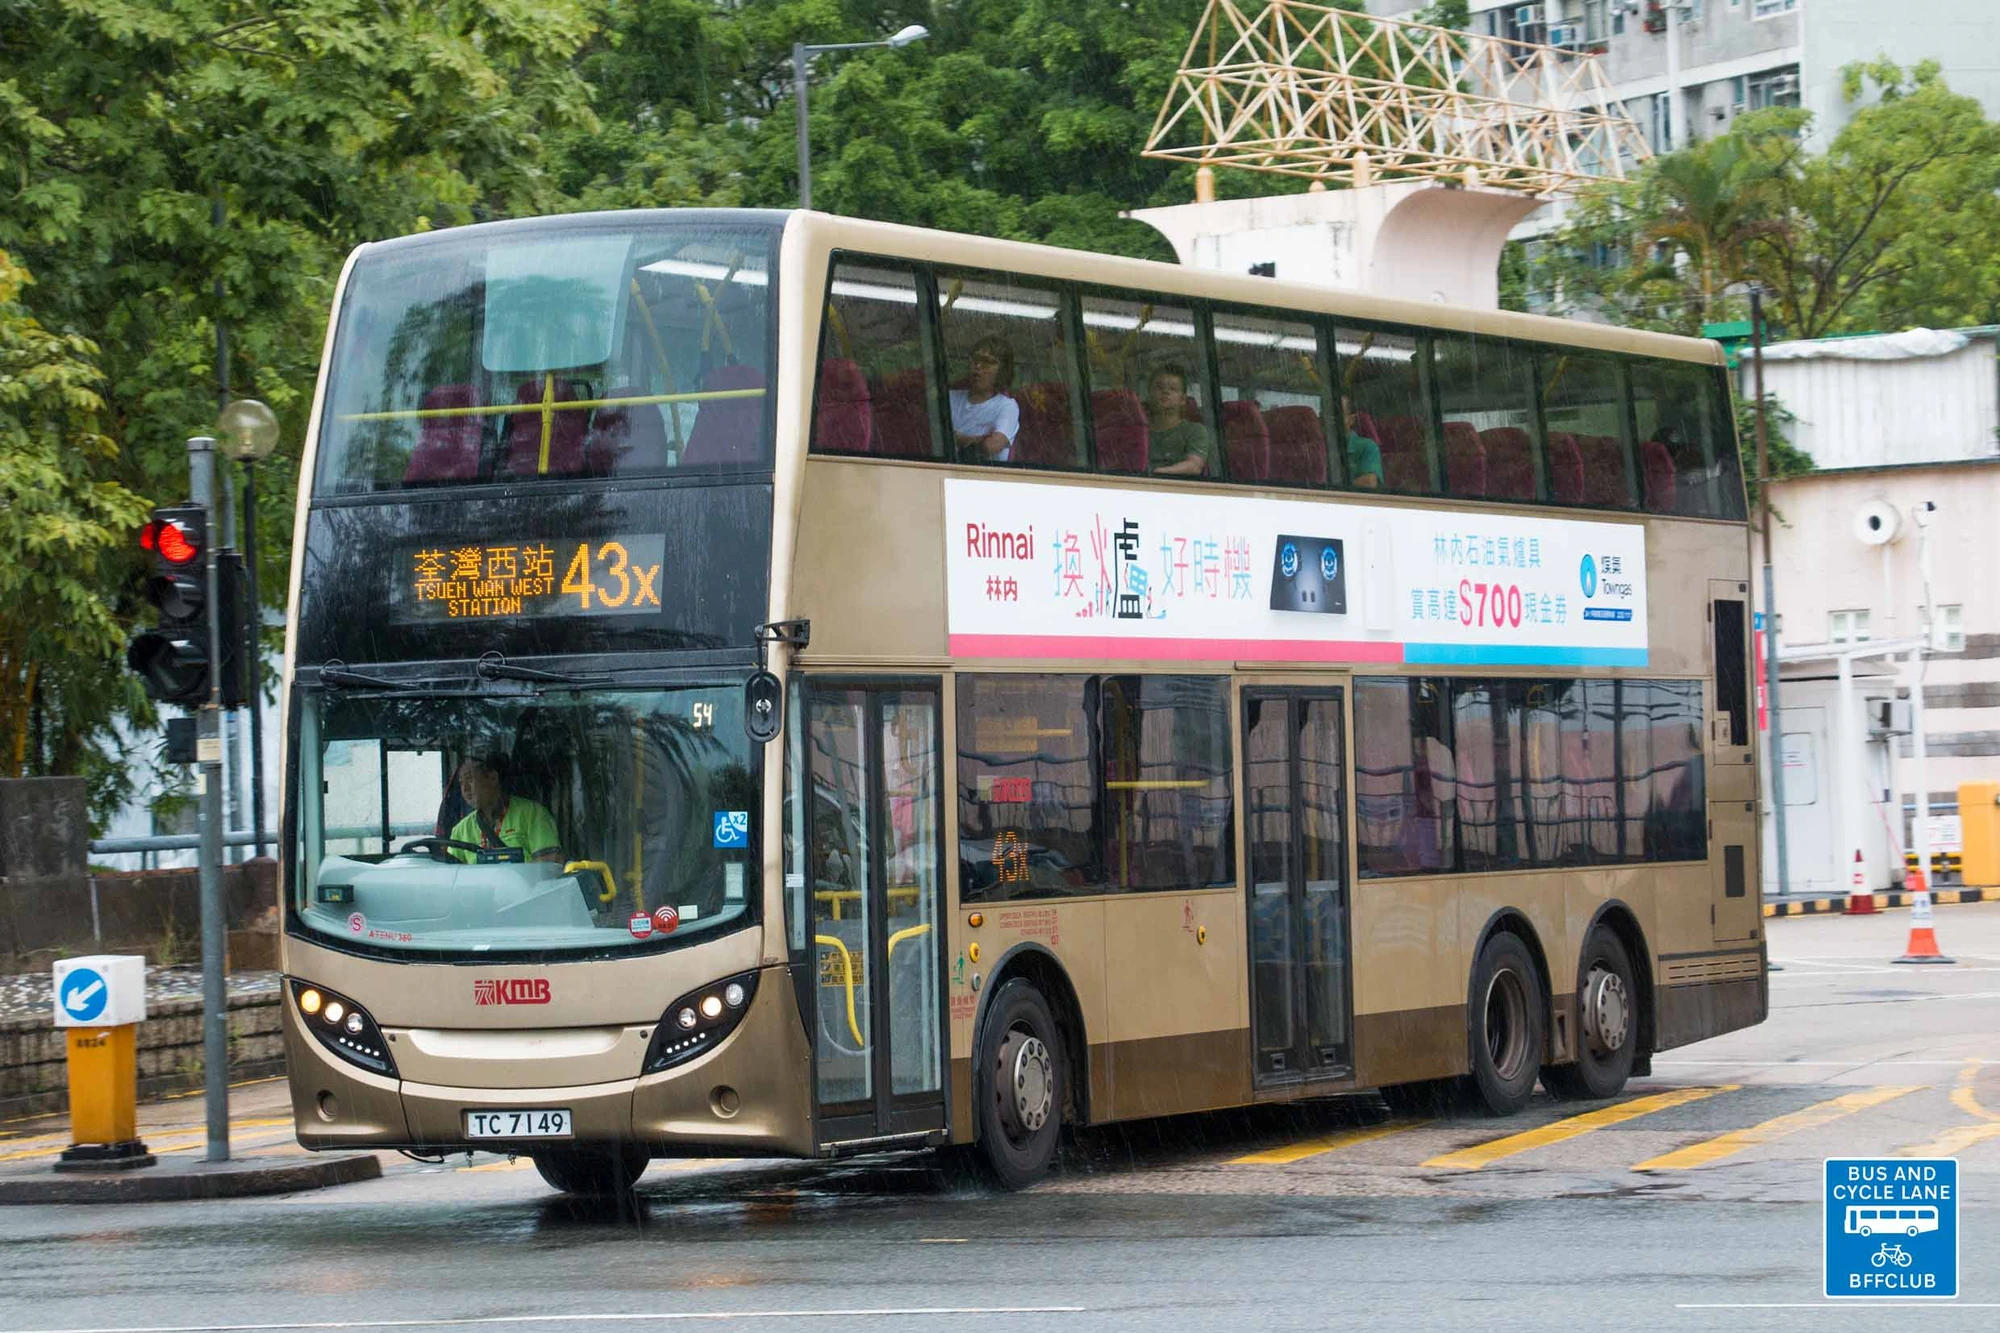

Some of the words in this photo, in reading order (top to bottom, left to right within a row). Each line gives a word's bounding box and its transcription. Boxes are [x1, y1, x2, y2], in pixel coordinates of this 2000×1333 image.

[966, 522, 1034, 560] Rinnai
[414, 544, 555, 582] 荃灣西站
[414, 581, 467, 601] TSUEN
[473, 579, 504, 598] WAN
[511, 577, 555, 596] WEST
[1601, 578, 1632, 599] Towngas
[449, 597, 521, 617] STATION
[693, 702, 713, 728] 54
[351, 917, 362, 931] S
[495, 979, 551, 1005] KMB
[474, 1114, 501, 1135] TC
[509, 1112, 564, 1134] 7149
